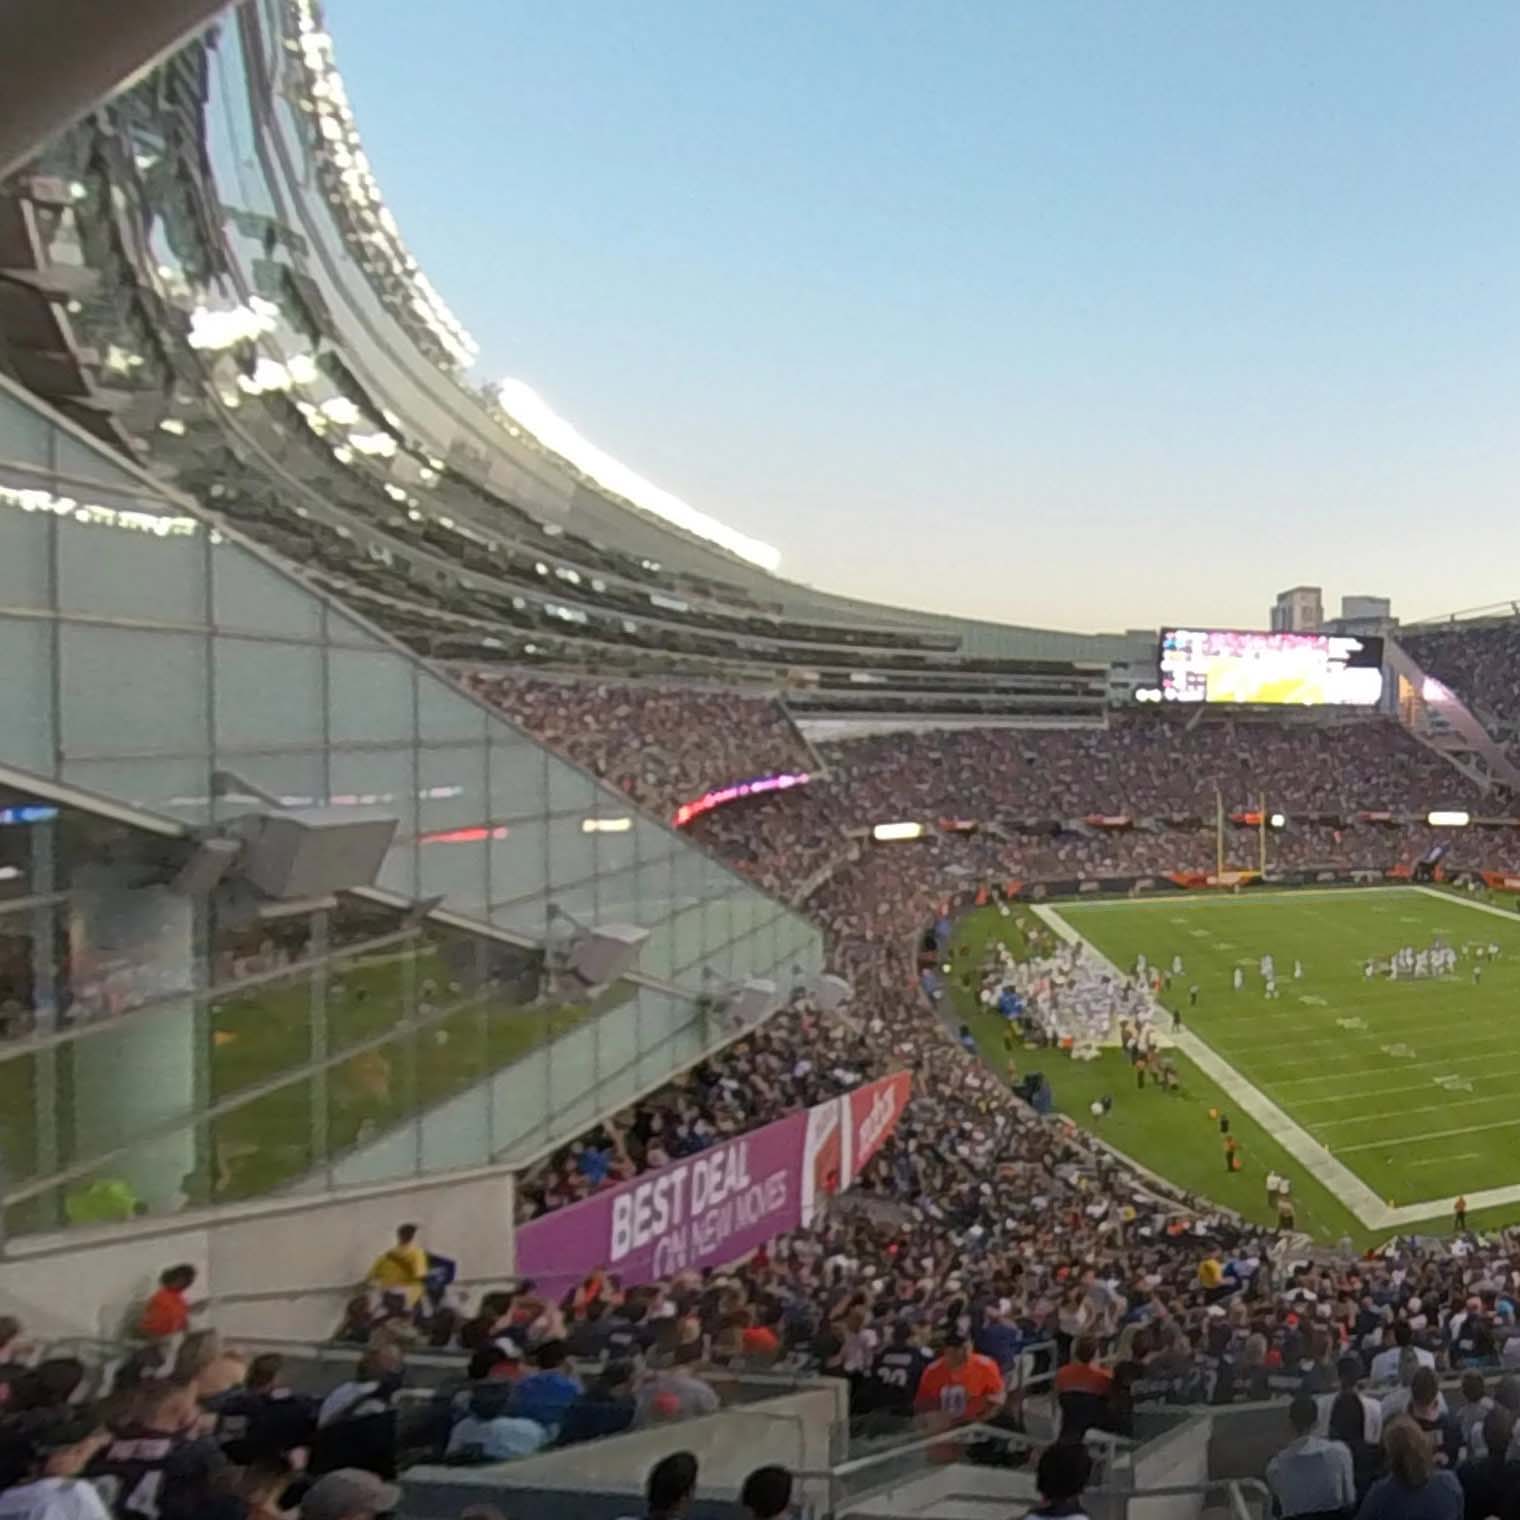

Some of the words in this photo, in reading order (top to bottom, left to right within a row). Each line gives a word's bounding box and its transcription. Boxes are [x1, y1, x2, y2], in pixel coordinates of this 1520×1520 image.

[611, 1166, 688, 1261] BEST
[691, 1141, 749, 1214] DEAL
[653, 1226, 687, 1280] ON
[690, 1202, 732, 1262] NEW
[734, 1170, 788, 1232] MOVIES
